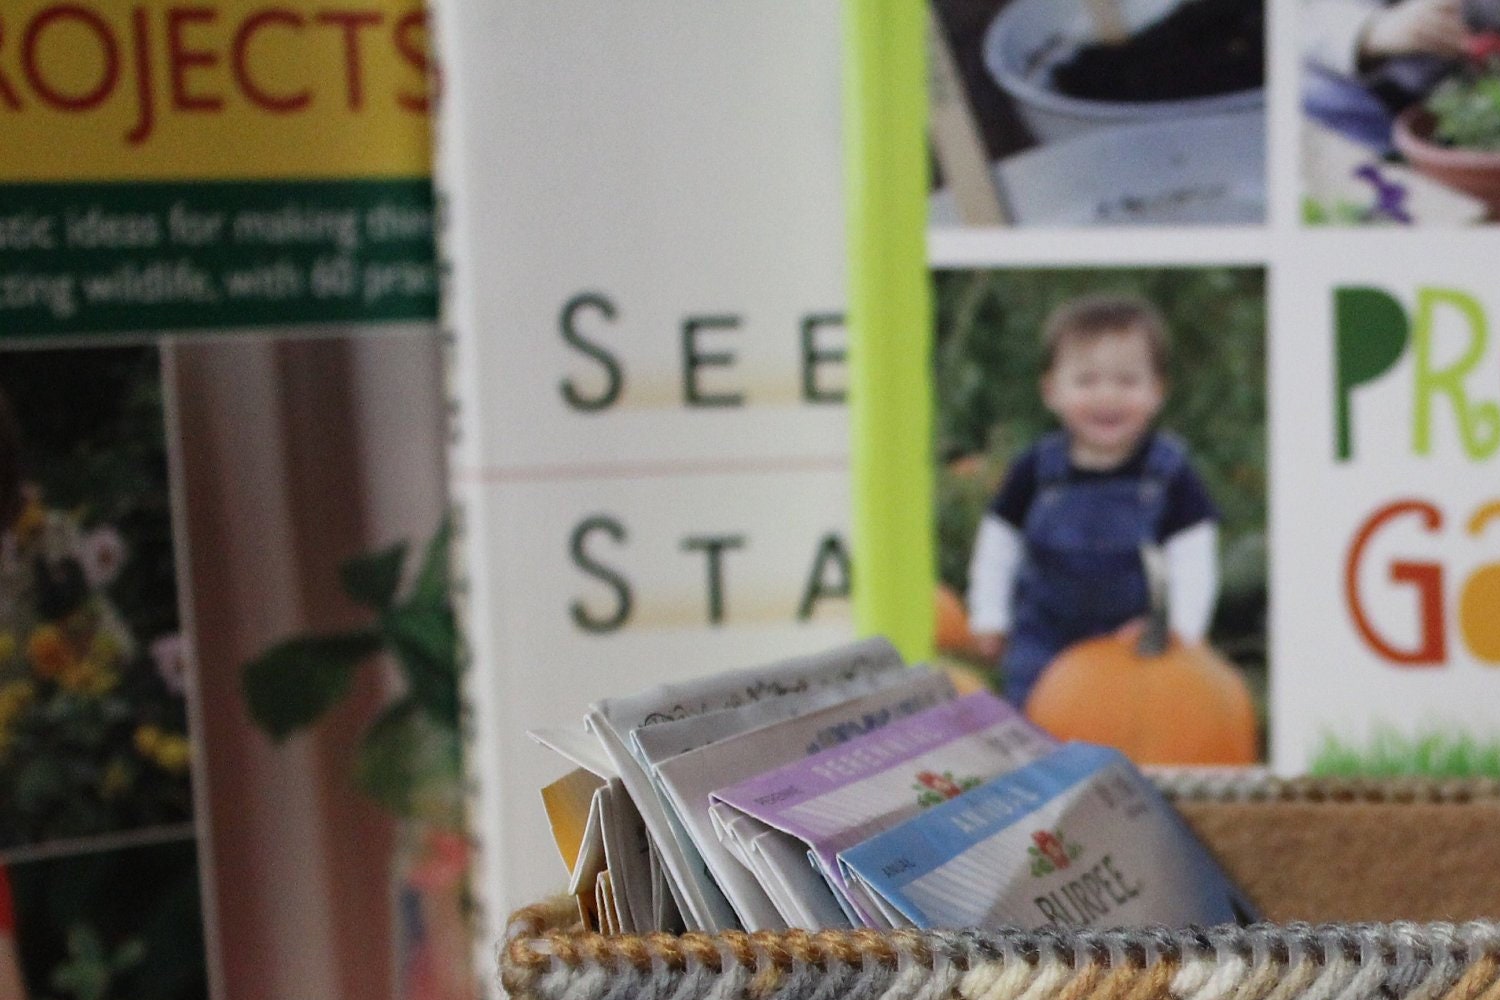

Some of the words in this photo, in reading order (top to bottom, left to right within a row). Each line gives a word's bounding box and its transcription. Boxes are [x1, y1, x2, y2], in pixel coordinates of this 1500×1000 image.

[169, 199, 224, 247] for
[558, 291, 848, 413] SEE
[568, 515, 852, 635] STA
[1033, 853, 1142, 927] BURPEE
